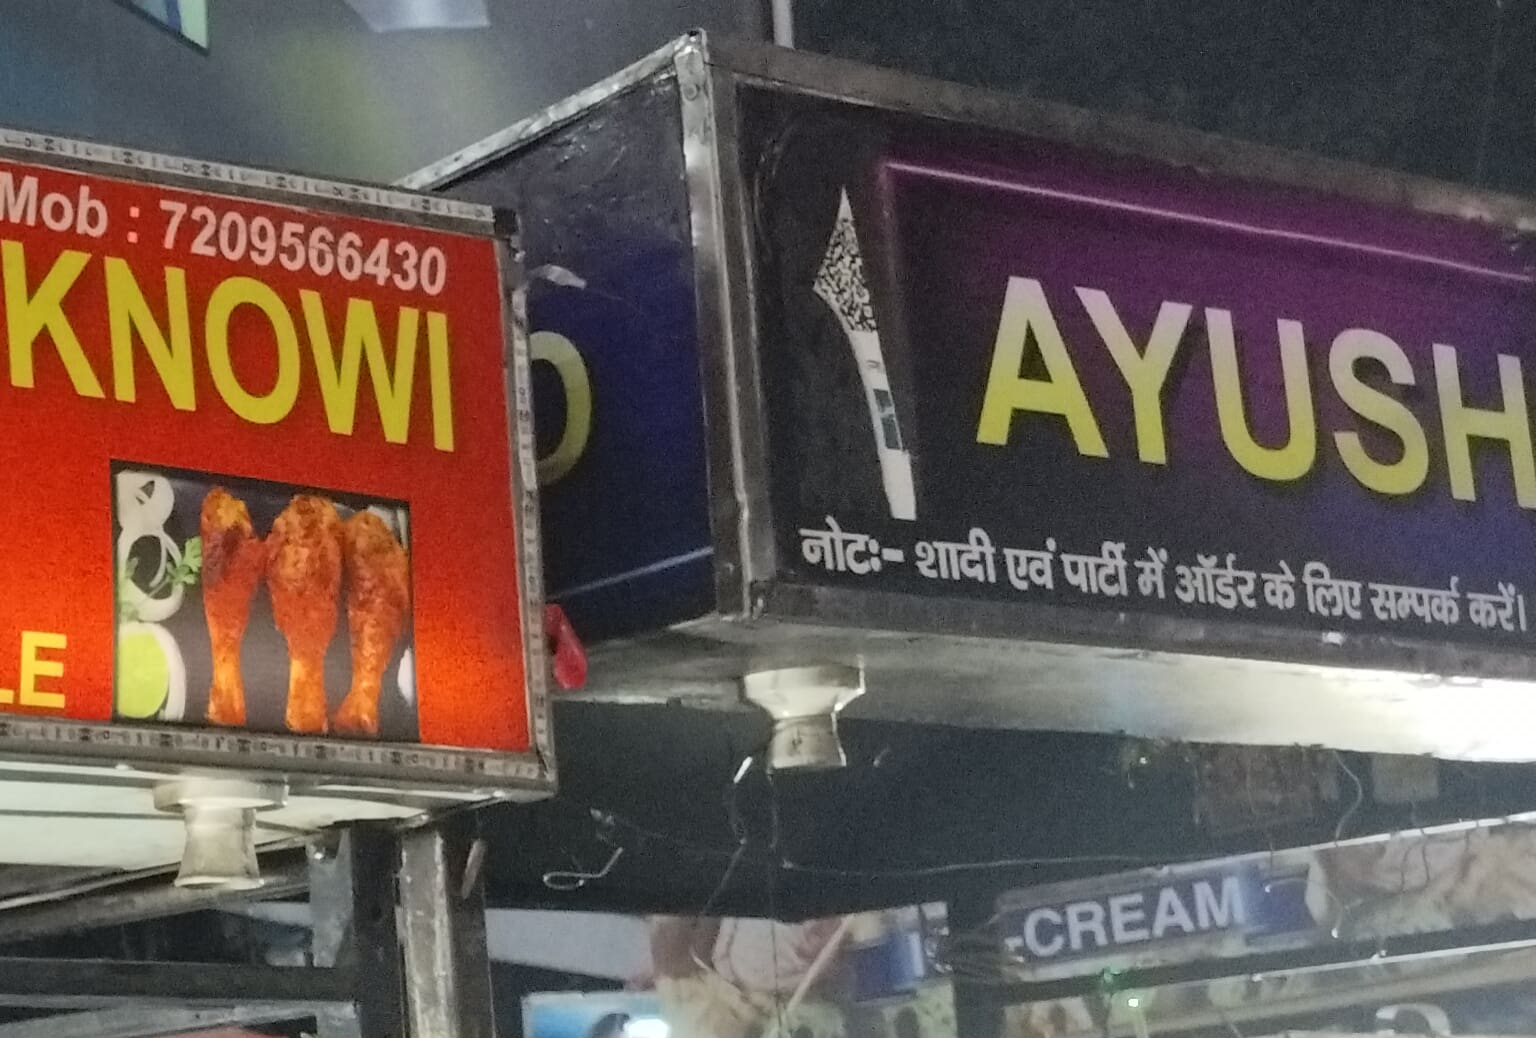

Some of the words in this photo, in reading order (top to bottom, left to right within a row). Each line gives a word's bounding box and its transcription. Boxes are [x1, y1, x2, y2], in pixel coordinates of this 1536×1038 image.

[159, 199, 447, 296] 7209566430
[976, 275, 1536, 510] AYUSH
[915, 528, 997, 584] शादी
[1003, 537, 1057, 591] एवं
[1061, 541, 1127, 597] पार्टी
[1134, 546, 1169, 600] में
[1175, 553, 1257, 609] ऑर्डर
[1261, 559, 1296, 610] के
[1303, 561, 1363, 620] लिए
[1368, 576, 1461, 625] सम्पर्क
